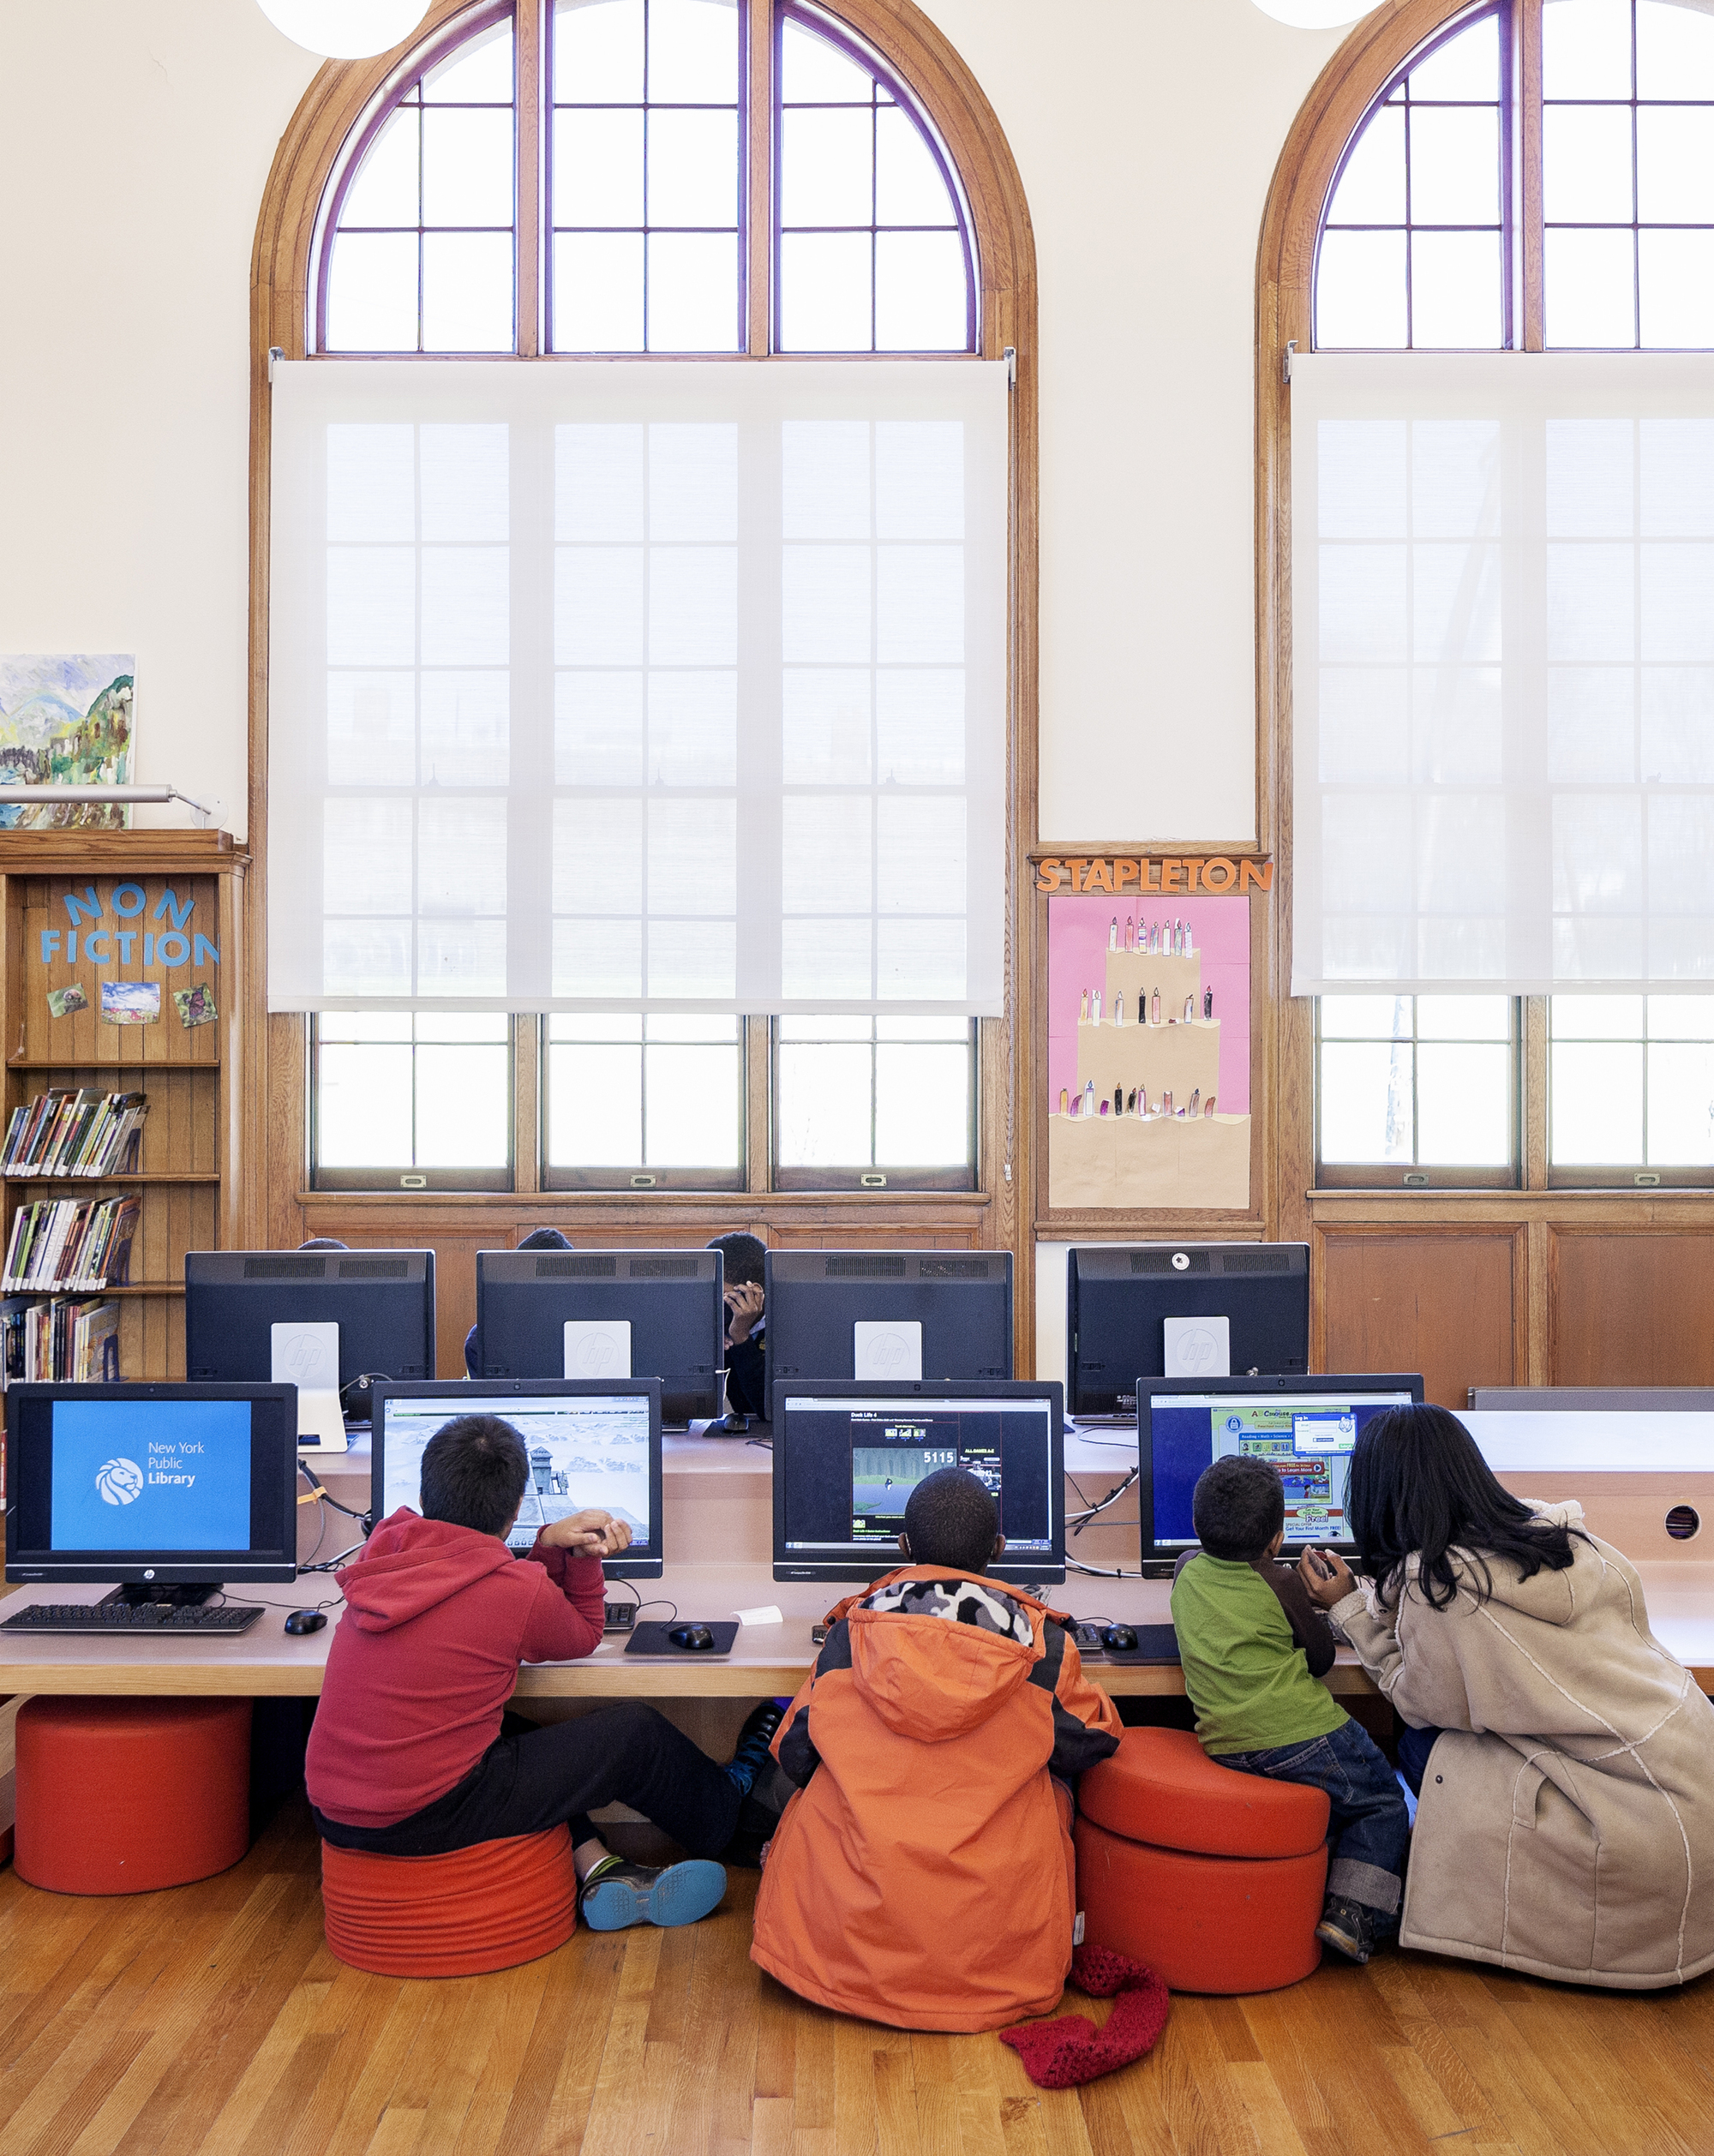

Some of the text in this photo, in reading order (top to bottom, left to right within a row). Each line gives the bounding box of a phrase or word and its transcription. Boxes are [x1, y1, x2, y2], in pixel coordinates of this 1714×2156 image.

[1035, 857, 1274, 892] STAPLETON
[63, 882, 195, 930] NON
[40, 930, 220, 967] FICTION
[290, 1334, 321, 1378] hp
[583, 1333, 614, 1376] hp
[873, 1333, 905, 1377] hp
[1182, 1328, 1213, 1372] hp
[148, 1441, 205, 1453] New York
[148, 1457, 183, 1469] Public
[924, 1452, 954, 1463] 5115
[148, 1472, 195, 1488] Library
[1305, 1513, 1328, 1523] Free!
